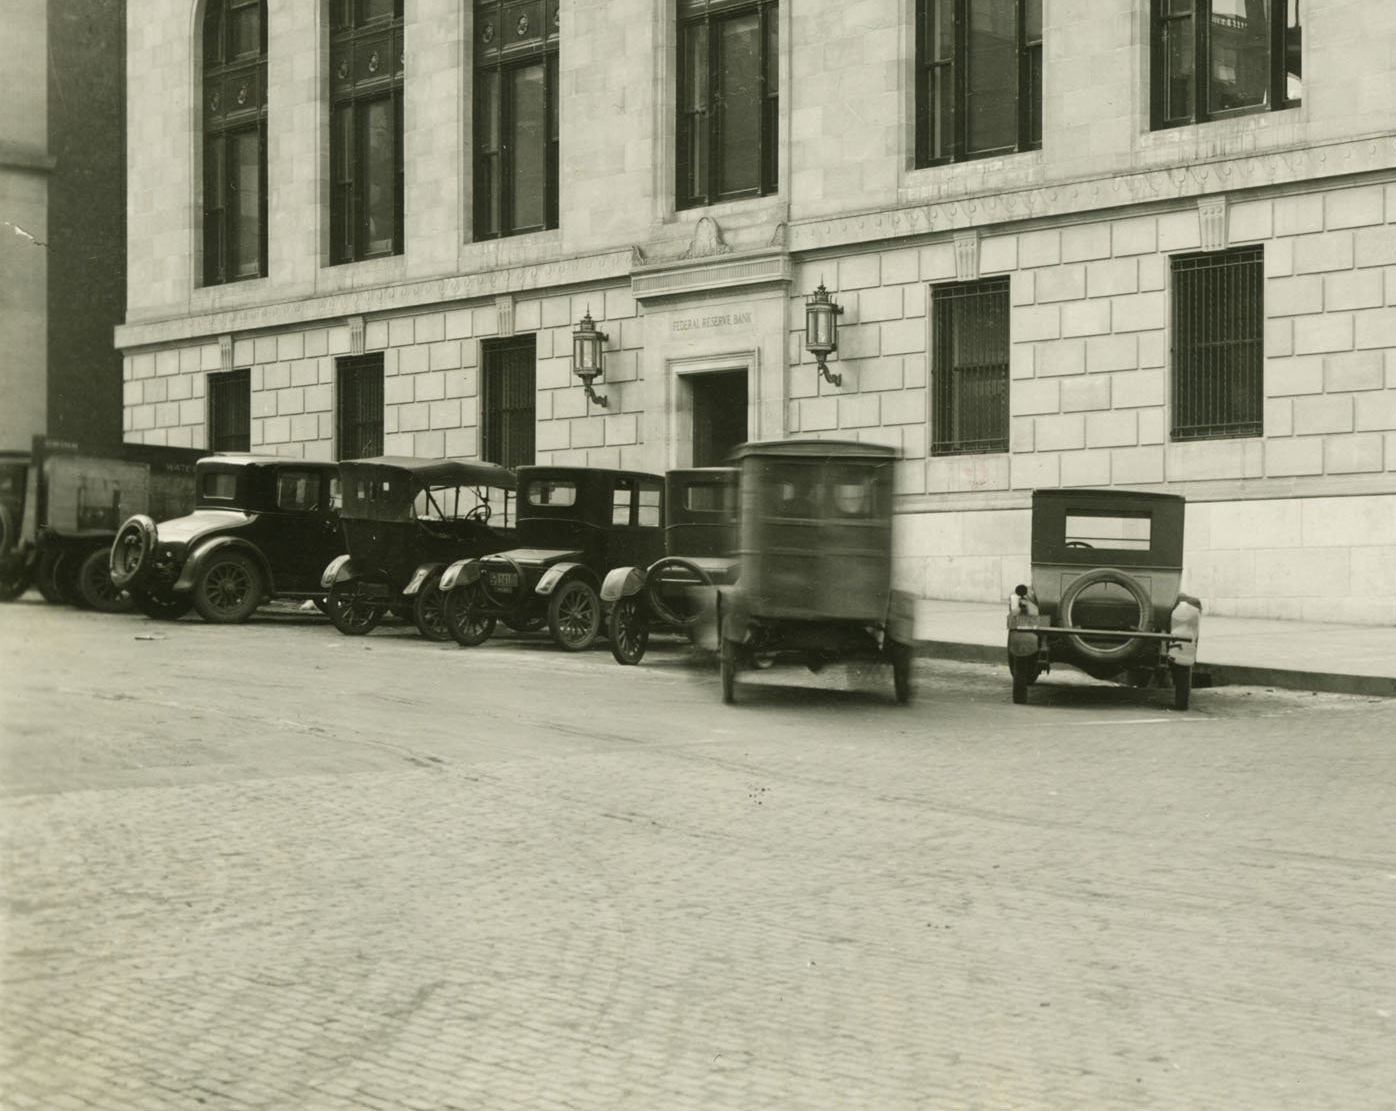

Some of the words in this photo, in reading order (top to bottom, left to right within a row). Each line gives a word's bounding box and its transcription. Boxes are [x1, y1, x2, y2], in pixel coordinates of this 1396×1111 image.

[672, 318, 700, 331] FEDERAL
[702, 314, 731, 328] RESERVE
[733, 312, 752, 325] BANK
